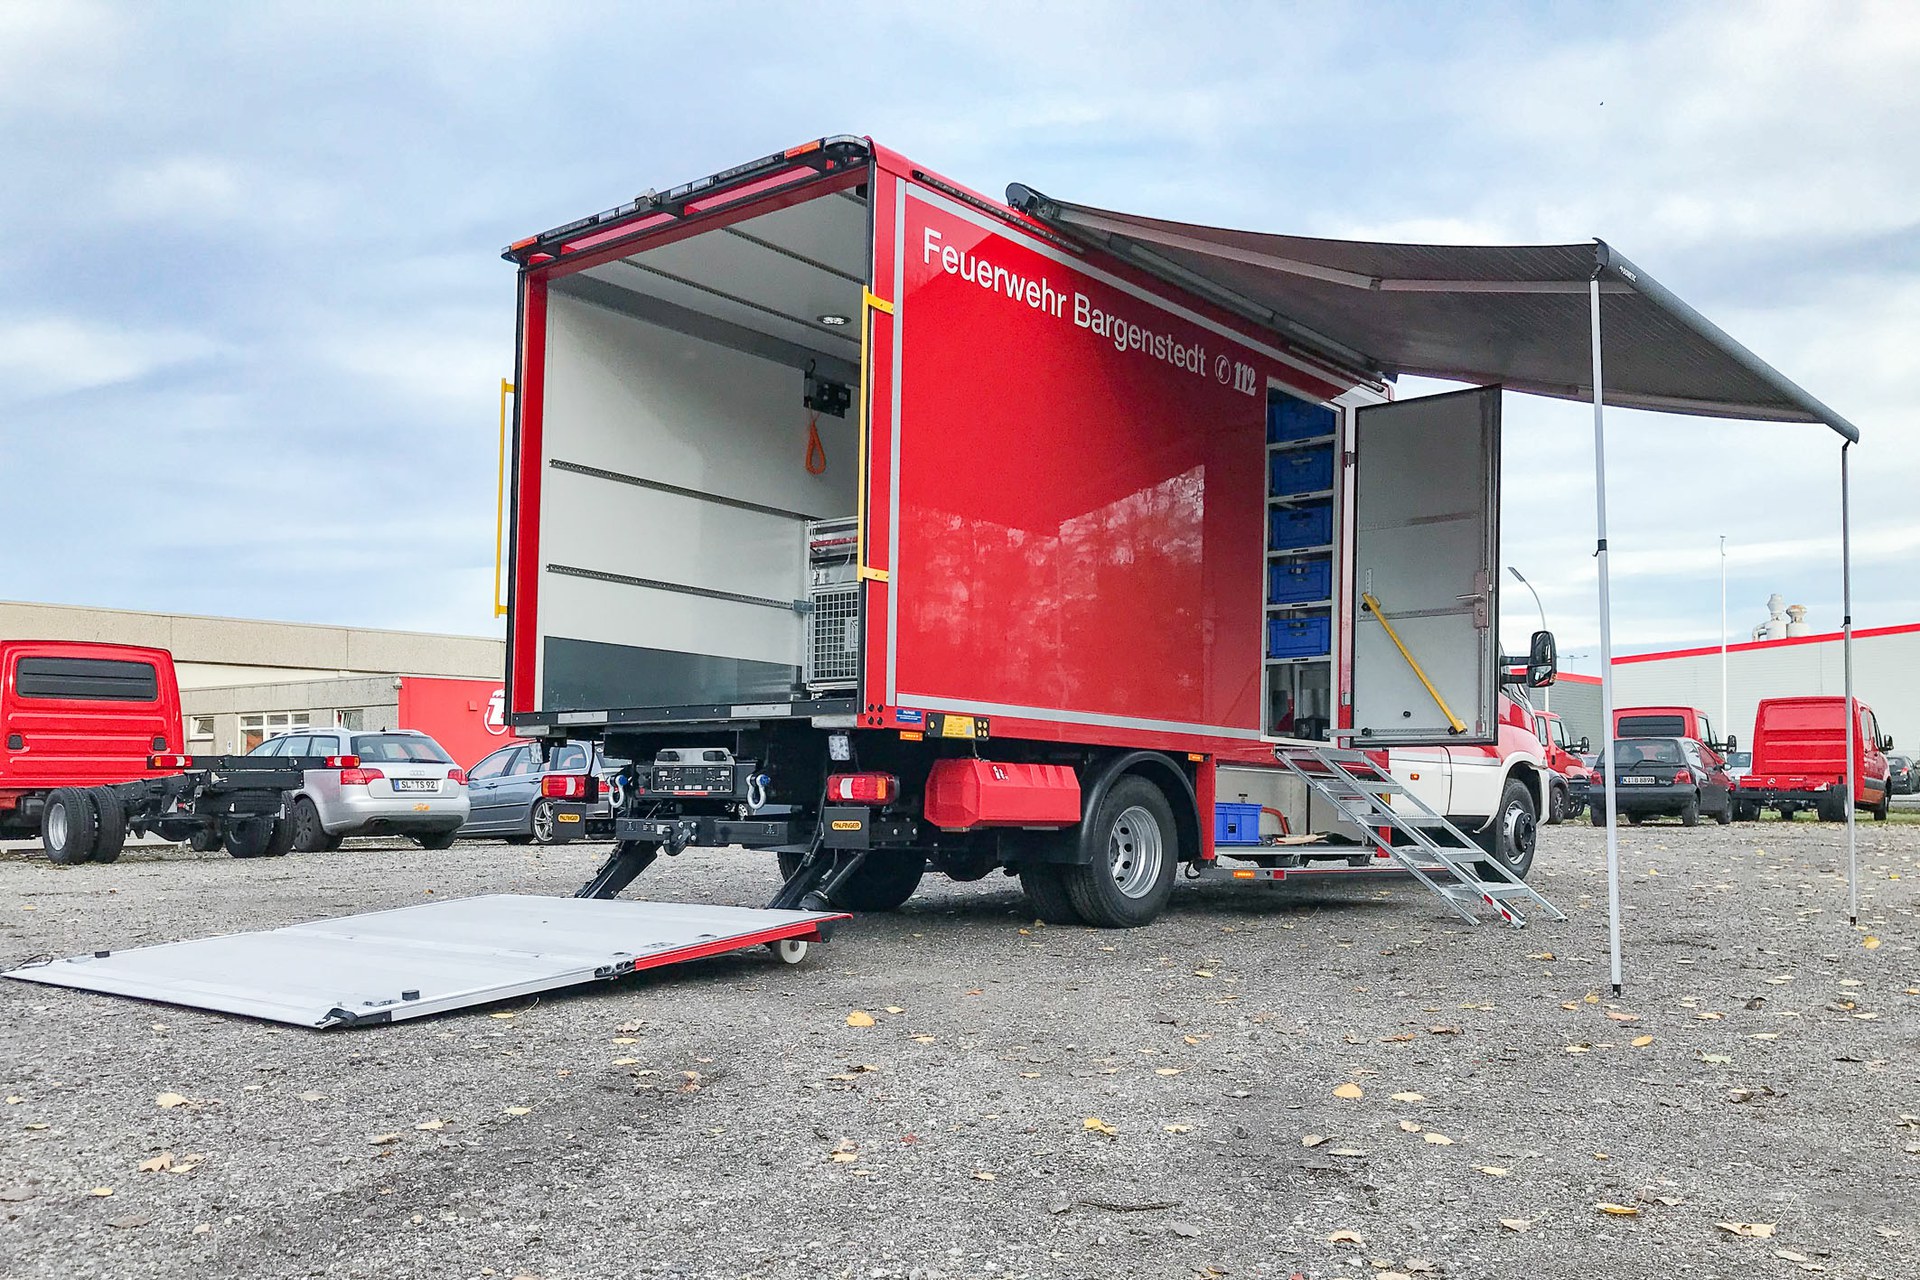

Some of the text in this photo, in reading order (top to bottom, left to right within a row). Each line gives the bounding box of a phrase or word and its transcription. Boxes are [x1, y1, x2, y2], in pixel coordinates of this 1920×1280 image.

[923, 226, 1257, 397] Feuerwehr Bargenstedt 112
[401, 780, 435, 789] SL TS 92
